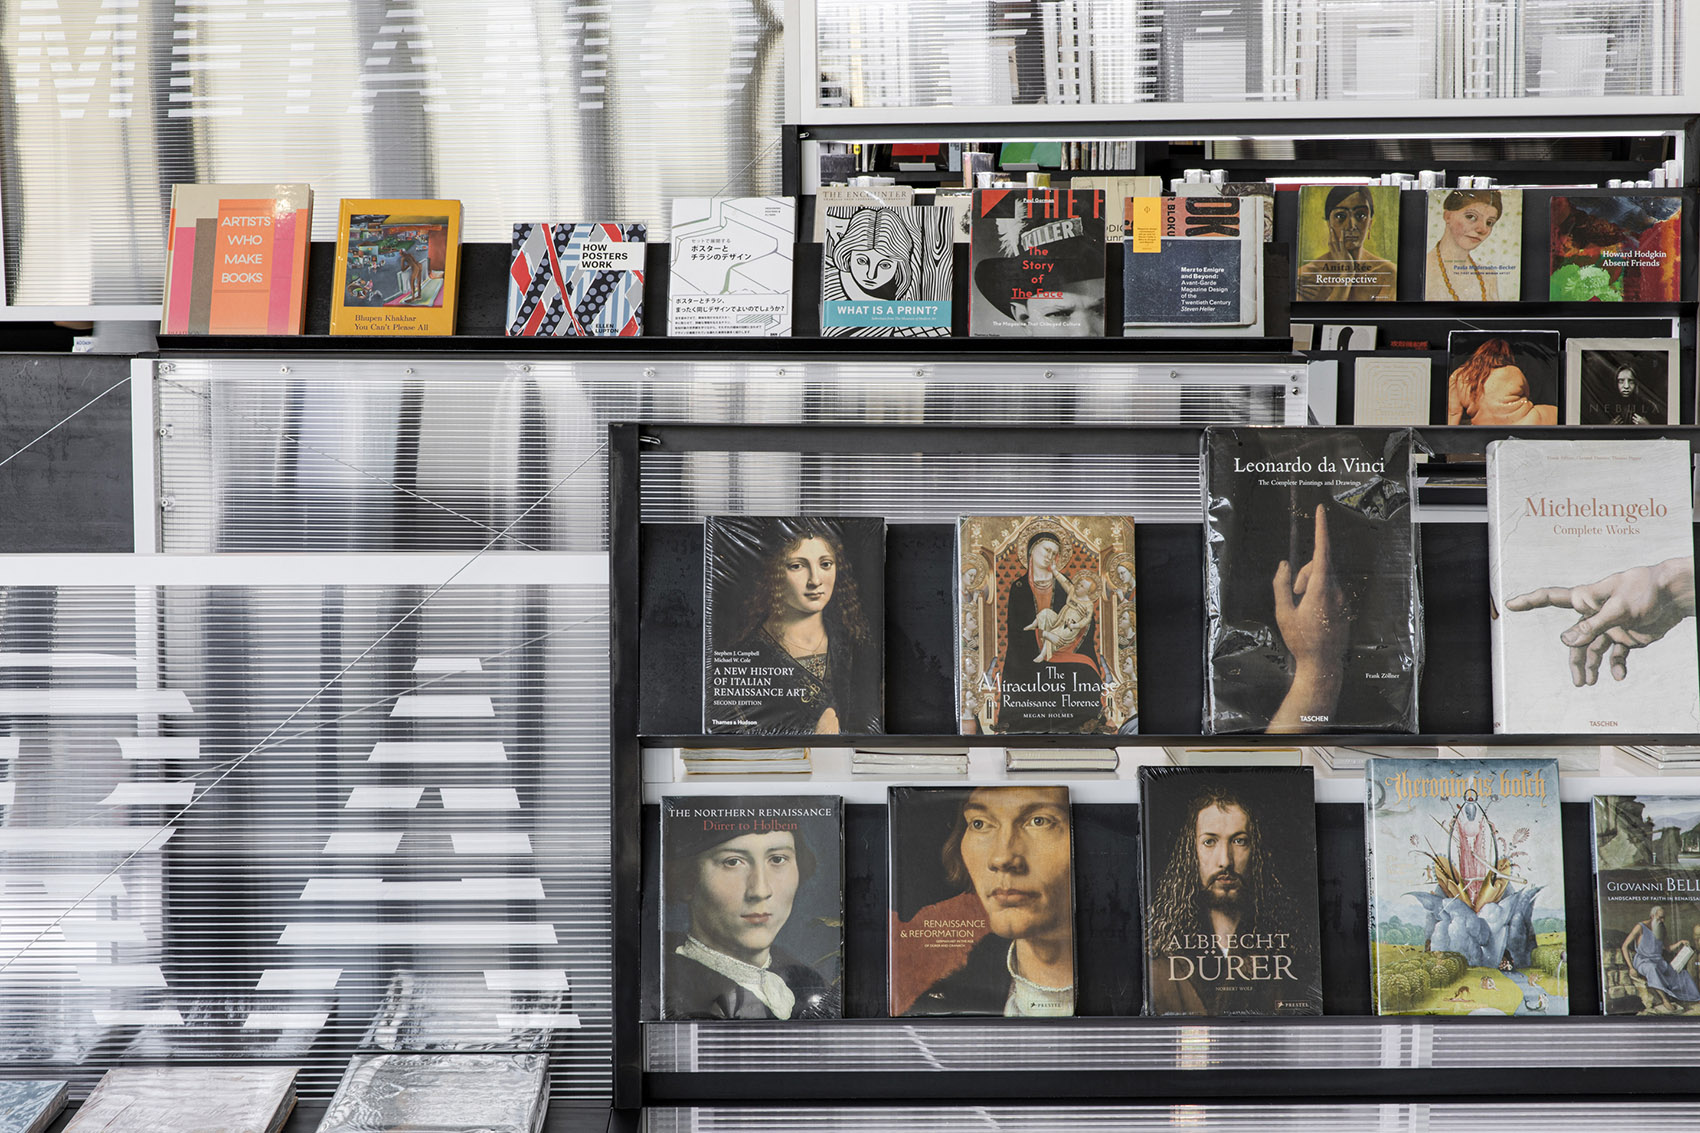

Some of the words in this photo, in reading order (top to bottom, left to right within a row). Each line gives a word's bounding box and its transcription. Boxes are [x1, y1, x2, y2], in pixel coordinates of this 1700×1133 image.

[221, 216, 271, 227] ARTISTS
[227, 234, 263, 245] WHO
[1024, 221, 1076, 248] KILLER
[582, 252, 628, 260] POSTERS
[1028, 246, 1049, 256] The
[1602, 250, 1633, 258] Howard
[1634, 250, 1667, 259] Hodgkin
[224, 254, 263, 265] MAKE
[691, 253, 752, 261] チラシのデザイン
[1022, 260, 1054, 272] Story
[1322, 262, 1351, 272] Anita
[1355, 261, 1372, 272] Rée
[1602, 259, 1629, 267] Absent
[1631, 259, 1660, 267] Friends
[221, 272, 263, 283] BOOKS
[1031, 274, 1045, 284] of
[1316, 274, 1378, 286] Retrospective
[1011, 288, 1033, 298] The
[1036, 288, 1064, 298] Face
[837, 306, 870, 315] WHAT
[872, 306, 884, 315] IS
[886, 306, 895, 315] A
[897, 306, 938, 315] PRINT?
[1588, 403, 1660, 413] NEBULA
[1233, 456, 1312, 473] Leonardo
[1317, 456, 1337, 473] da
[1342, 457, 1386, 473] Vinci
[1271, 479, 1298, 487] Complete
[1298, 479, 1323, 487] Paintings
[1335, 479, 1361, 487] Drawings
[1525, 497, 1668, 524] Michelangelo
[1553, 525, 1603, 537] Complete
[1606, 525, 1641, 535] Works
[713, 667, 721, 675] A
[724, 667, 748, 676] NEW
[750, 667, 795, 676] HISTORY
[1046, 666, 1065, 679] The
[713, 677, 728, 686] OF
[730, 677, 772, 686] ITALIAN
[978, 672, 1066, 693] Miraculous
[1073, 672, 1117, 696] Image
[713, 688, 784, 696] RENAISSANCE
[786, 688, 807, 697] ART
[1003, 694, 1057, 708] Renaissance
[1061, 694, 1100, 708] Florence
[668, 808, 691, 818] THE
[694, 808, 755, 817] NORTHERN
[759, 808, 832, 817] RENAISSANCE
[703, 820, 736, 831] Dürer
[738, 821, 750, 831] to
[754, 819, 798, 831] Holbein
[1606, 882, 1663, 892] GIOVANNI
[924, 919, 986, 928] RENAISSANCE
[900, 930, 908, 938] &
[909, 929, 974, 938] REFORMATION
[1168, 933, 1290, 949] ALBRECHT
[1168, 950, 1298, 981] DÜRER
